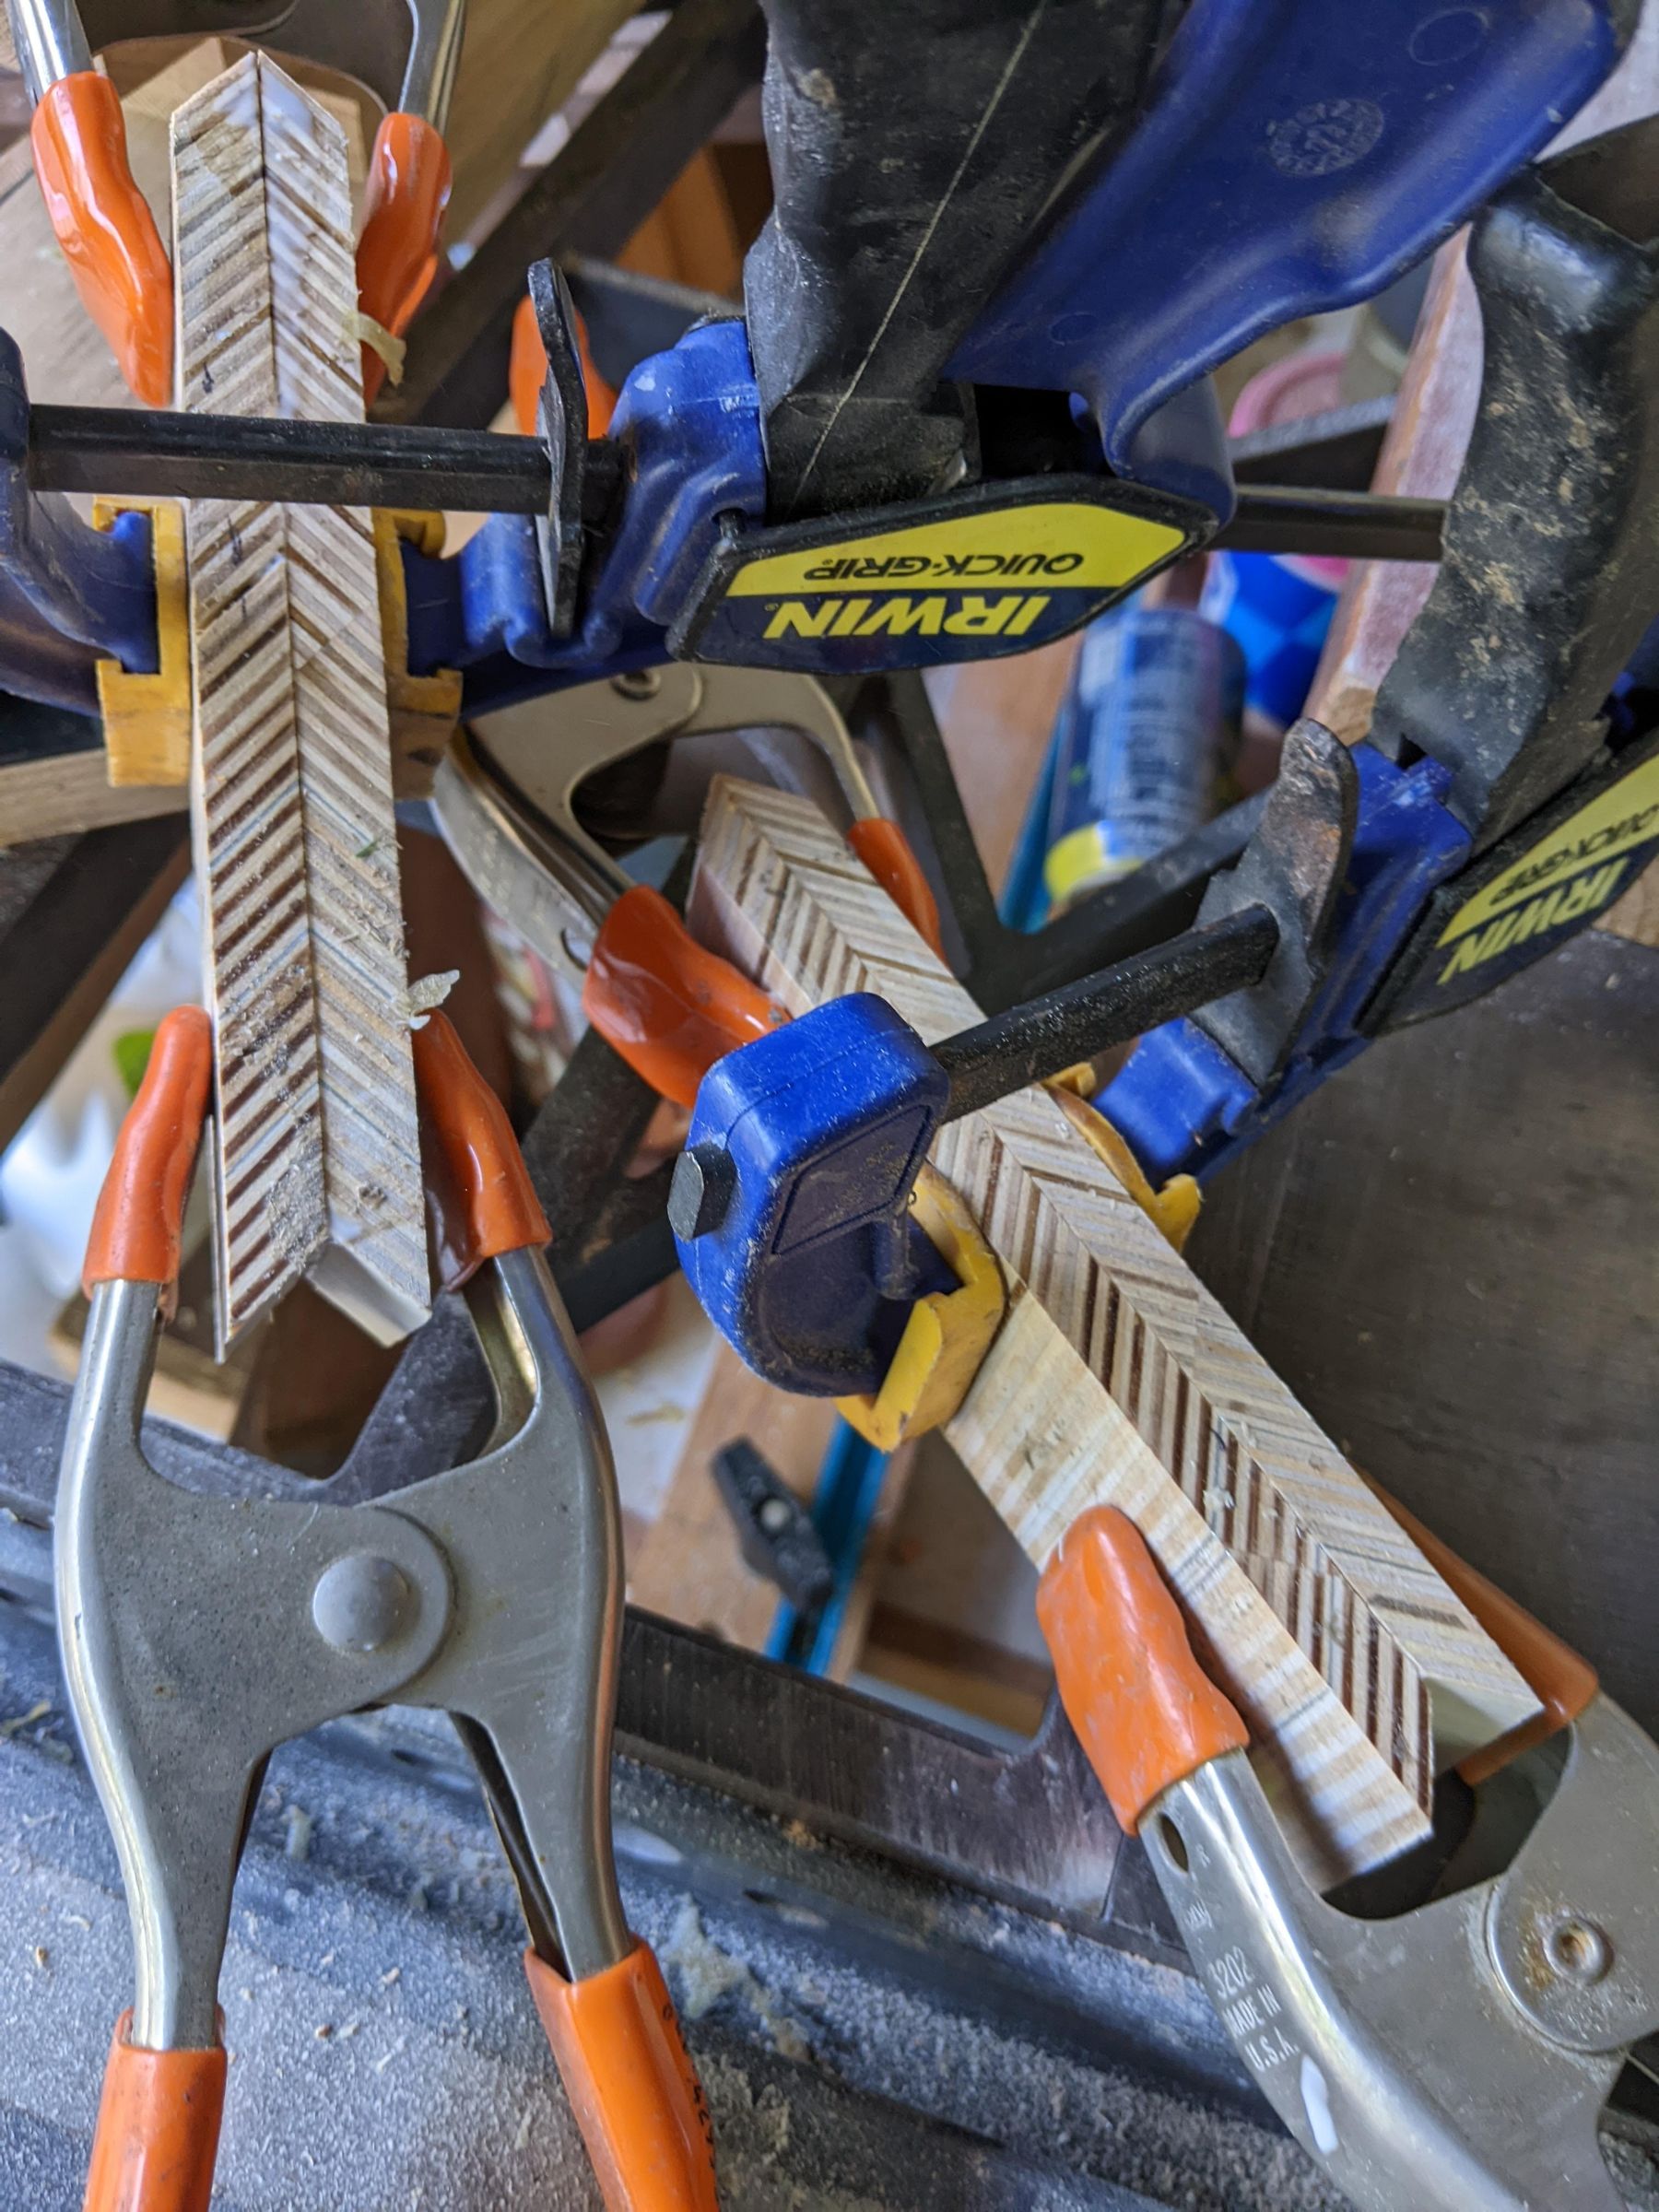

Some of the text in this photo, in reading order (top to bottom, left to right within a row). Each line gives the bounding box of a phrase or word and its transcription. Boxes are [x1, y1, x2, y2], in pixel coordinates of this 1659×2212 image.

[761, 595, 1052, 640] IRWIN
[1436, 856, 1630, 985] IRWIN
[1221, 1983, 1282, 2040] MADE IN
[1244, 2026, 1300, 2073] U.S.A.
